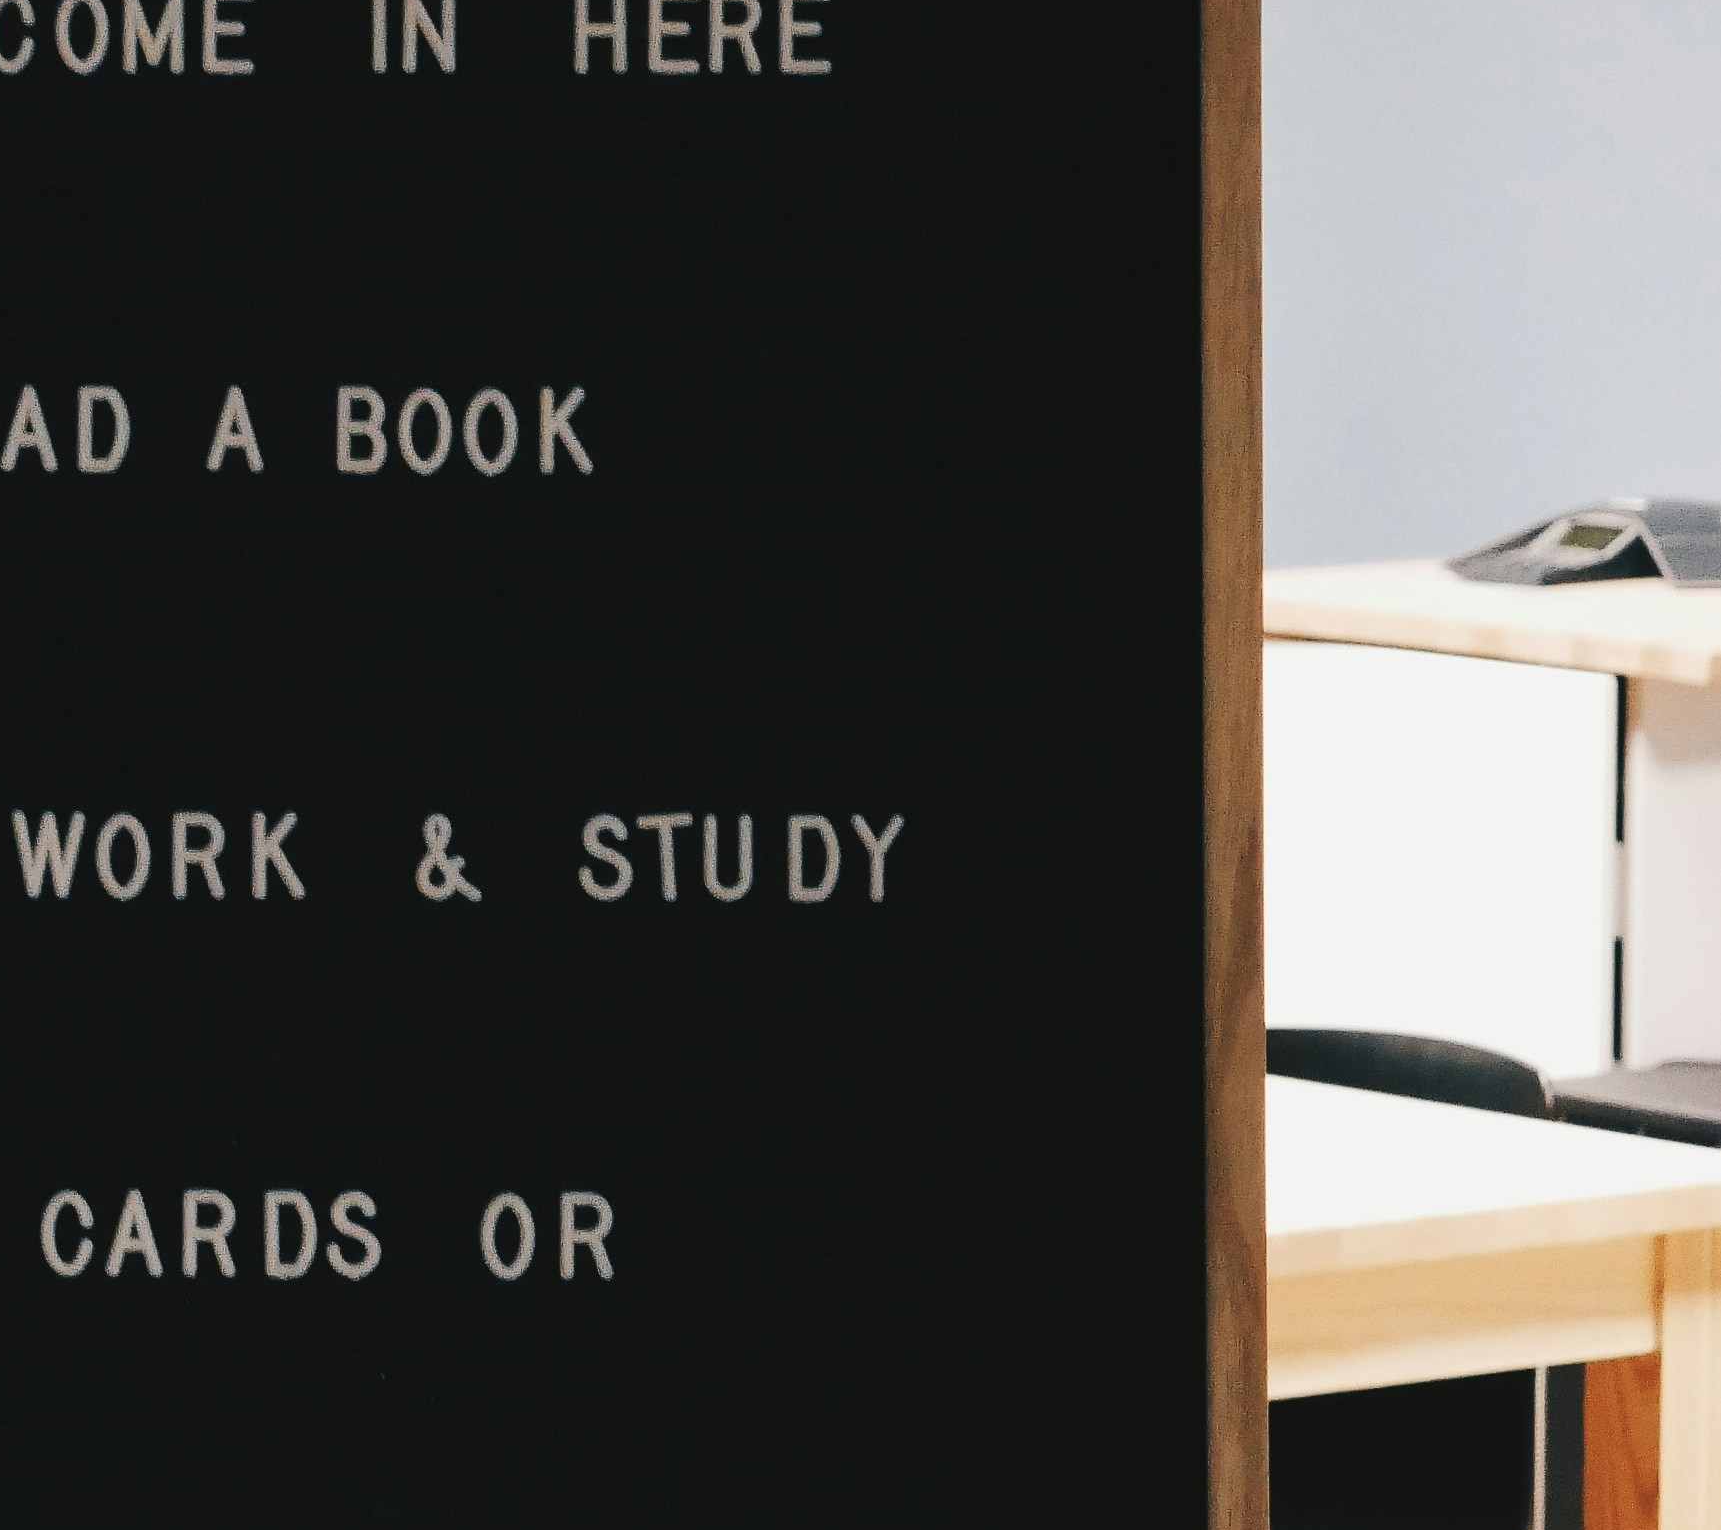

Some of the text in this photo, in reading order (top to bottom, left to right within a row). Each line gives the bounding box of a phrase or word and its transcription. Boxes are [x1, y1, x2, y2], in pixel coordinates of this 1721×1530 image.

[207, 386, 263, 471] A
[337, 386, 593, 477] BOOK
[12, 810, 904, 902] WORK & STUDY
[41, 1189, 381, 1281] CARDS
[481, 1192, 613, 1280] OR
